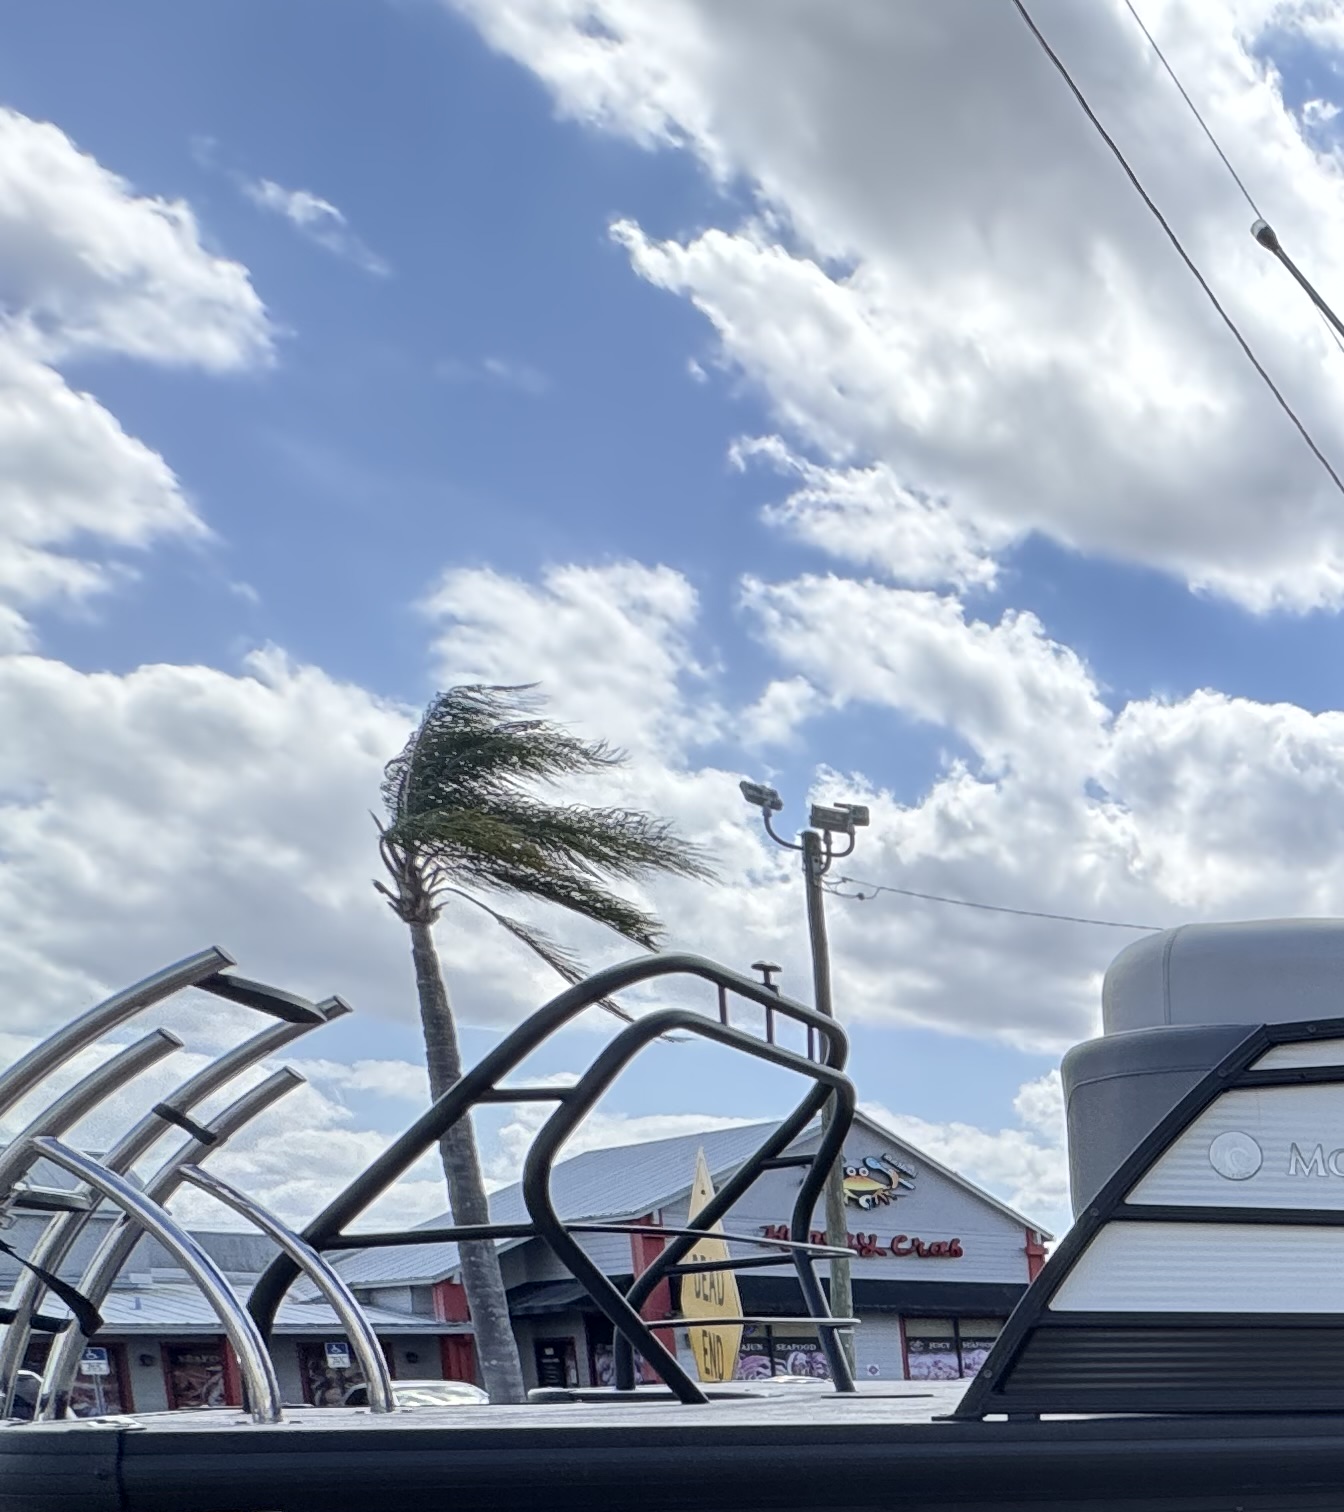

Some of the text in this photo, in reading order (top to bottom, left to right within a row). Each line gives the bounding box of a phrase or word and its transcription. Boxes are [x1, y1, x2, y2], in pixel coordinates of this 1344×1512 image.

[890, 1234, 964, 1258] Crab
[692, 1253, 725, 1307] DEAD
[702, 1329, 725, 1381] END
[741, 1343, 817, 1351] AJUN SEAFOOD
